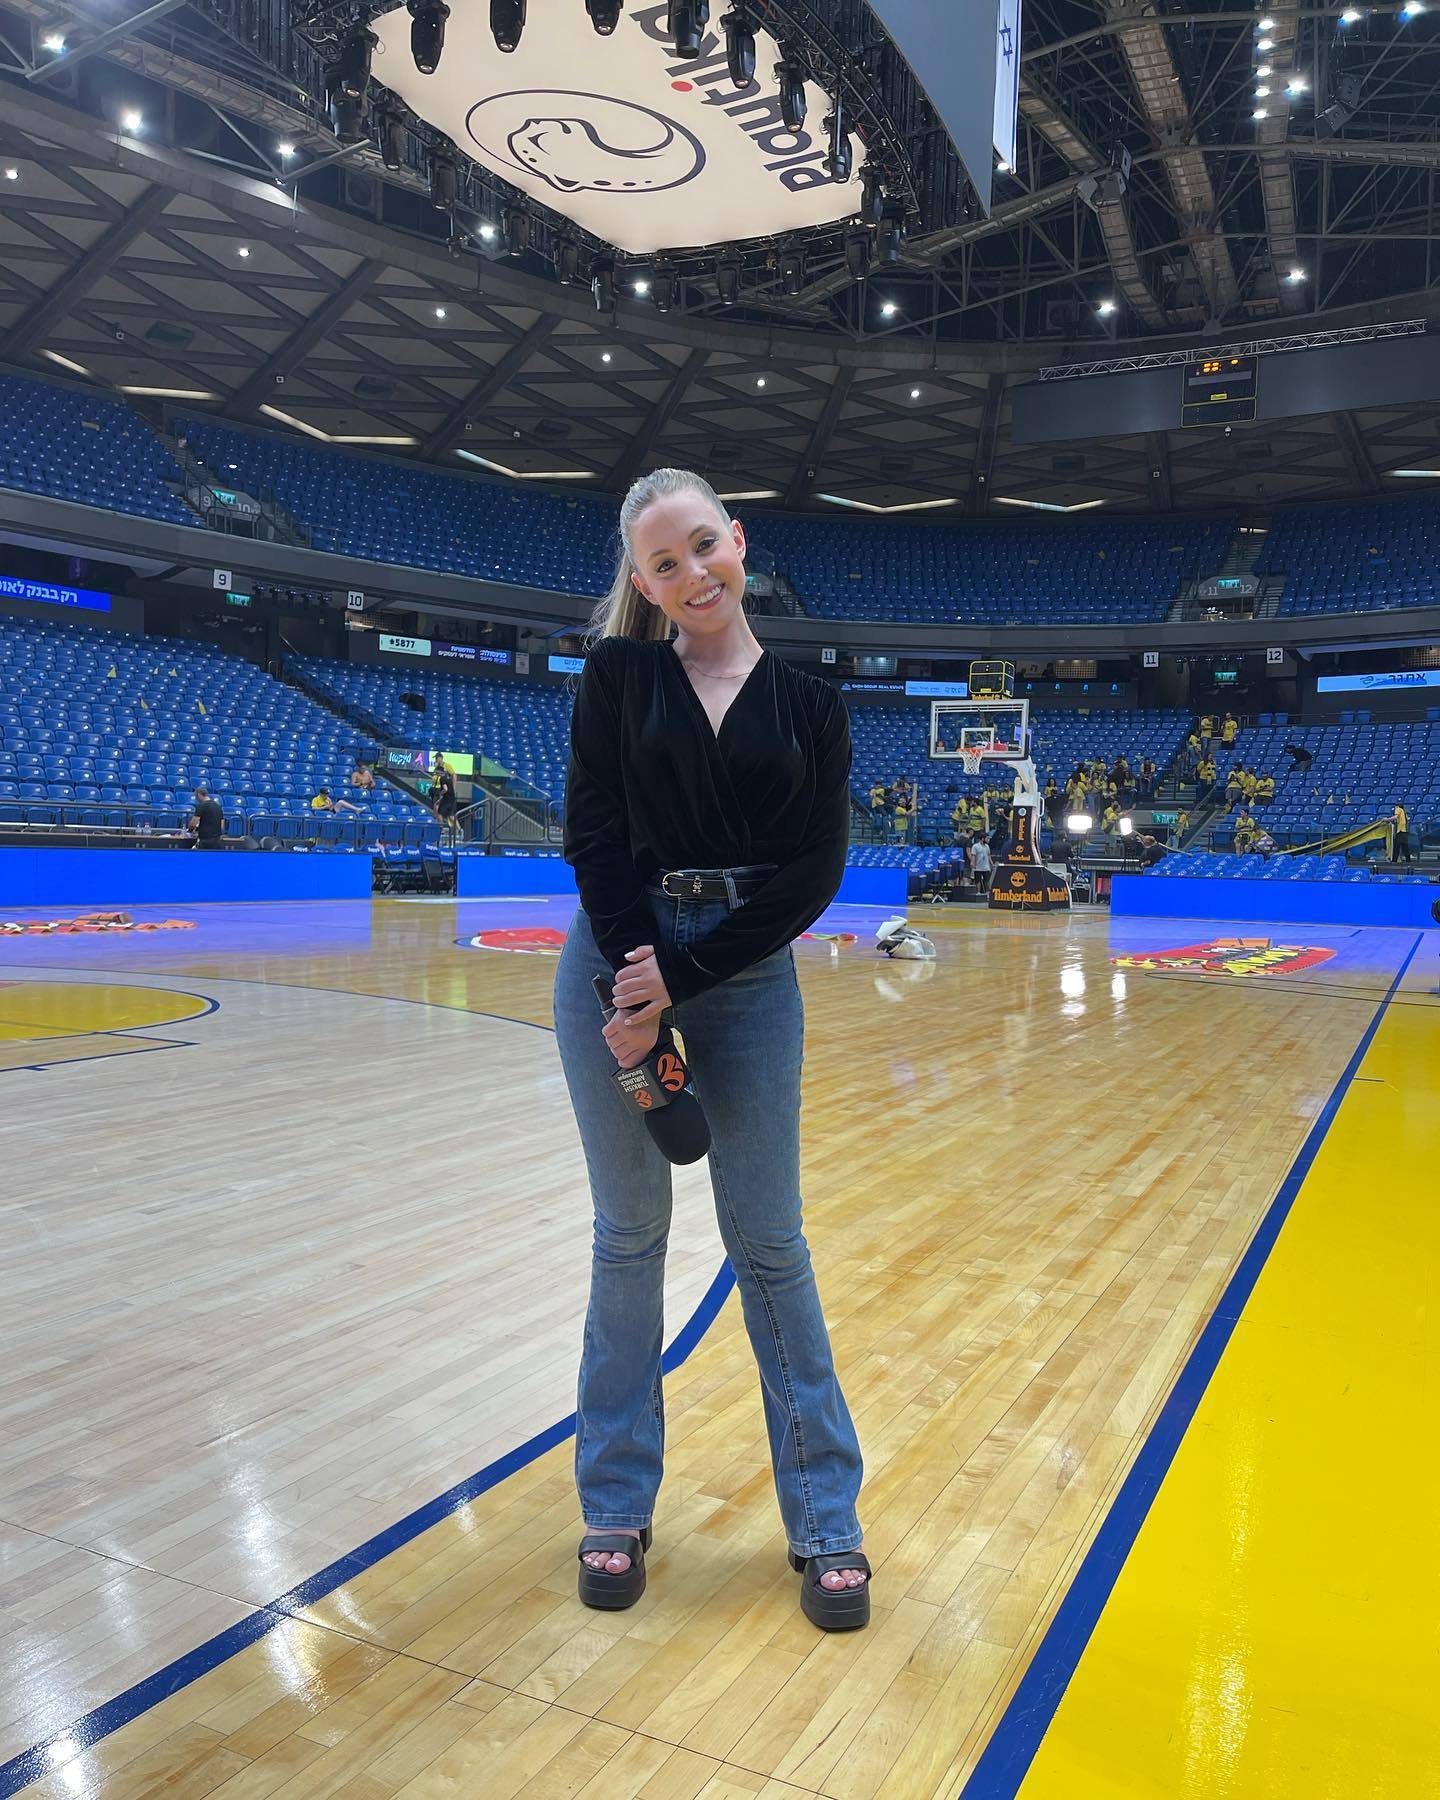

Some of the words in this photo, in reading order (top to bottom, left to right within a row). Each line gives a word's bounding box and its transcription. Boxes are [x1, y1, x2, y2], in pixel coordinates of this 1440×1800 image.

[218, 573, 227, 585] 9
[26, 584, 59, 600] בבנק
[60, 590, 78, 603] רק
[349, 594, 363, 607] 10
[824, 651, 834, 661] 11
[1145, 655, 1157, 665] 11
[1268, 651, 1281, 661] 12
[992, 887, 1043, 903] Timberland
[620, 1075, 645, 1087] AIRLINES
[623, 1080, 649, 1093] TURKISH
